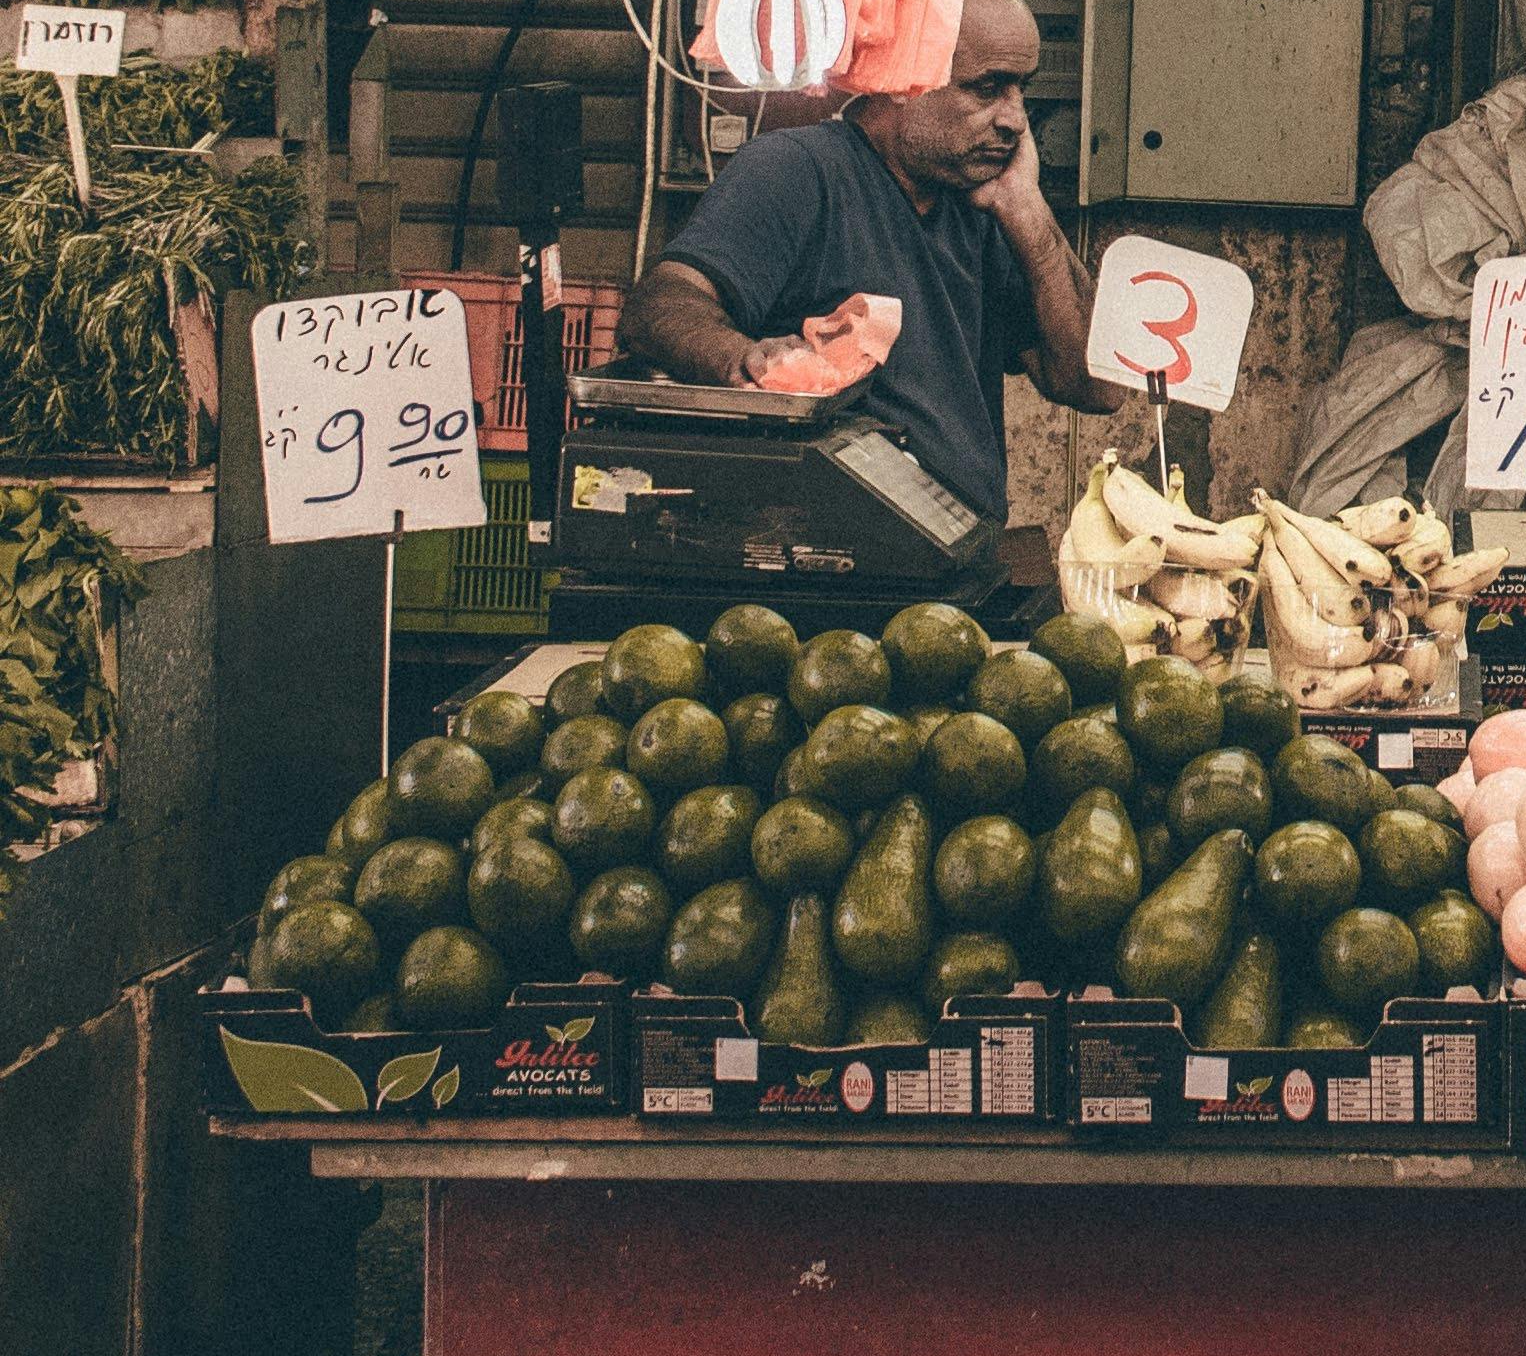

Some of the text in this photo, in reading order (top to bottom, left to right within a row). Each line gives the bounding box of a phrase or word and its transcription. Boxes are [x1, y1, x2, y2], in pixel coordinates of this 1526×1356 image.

[1114, 270, 1198, 385] 3
[303, 409, 365, 504] 9
[389, 402, 469, 452] 90
[506, 1069, 592, 1083] AVOCATS
[1286, 1086, 1313, 1098] RANI
